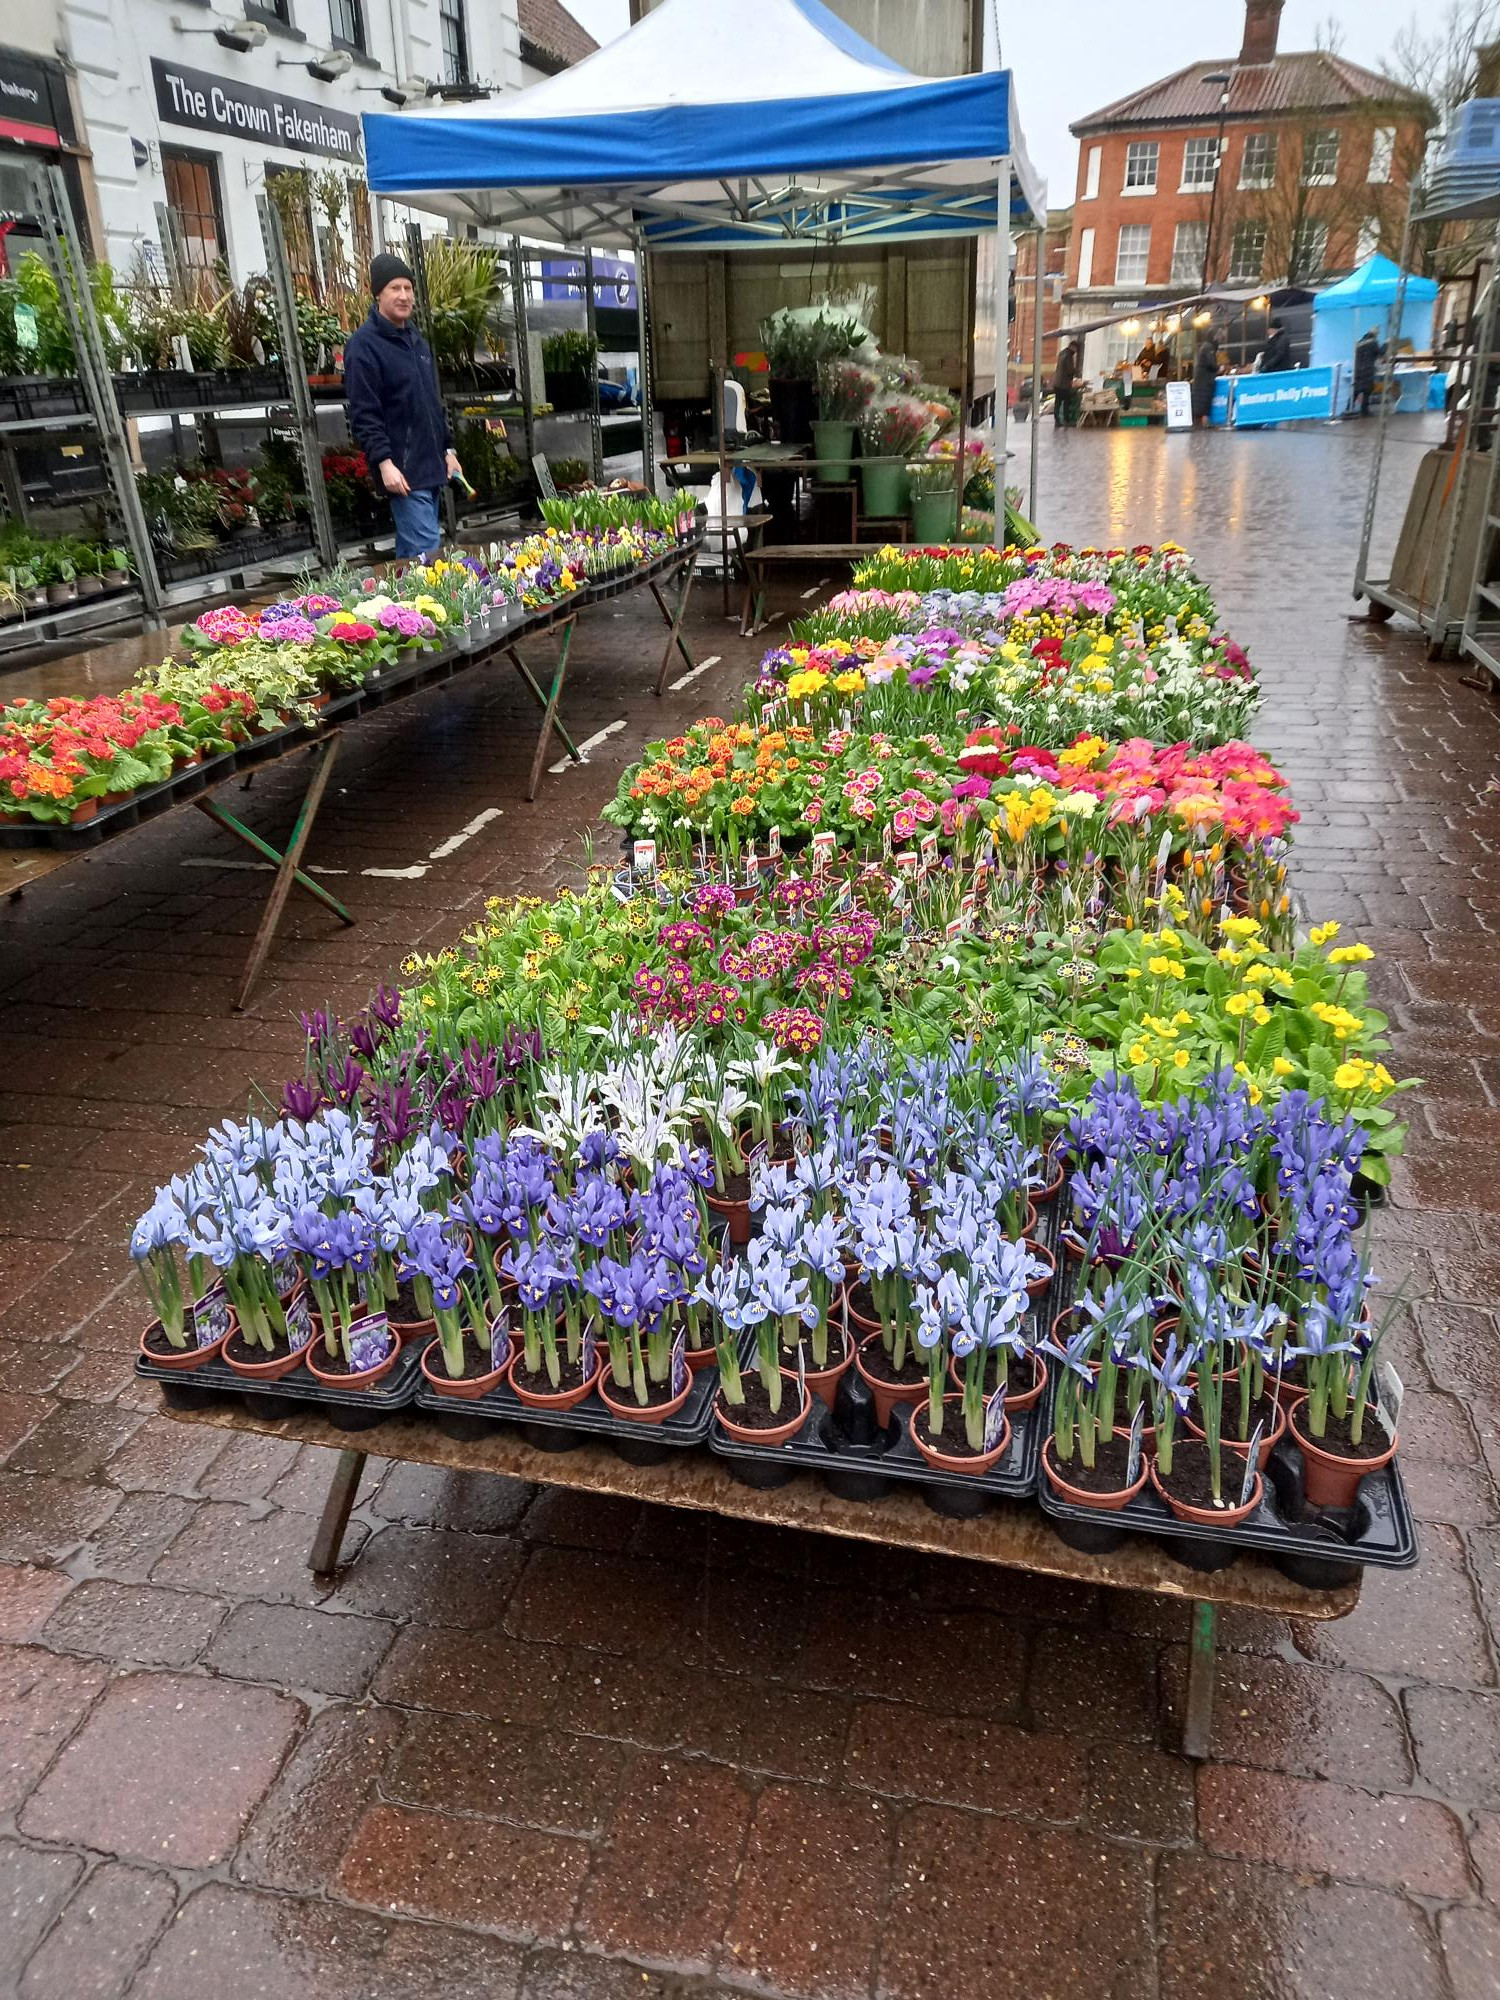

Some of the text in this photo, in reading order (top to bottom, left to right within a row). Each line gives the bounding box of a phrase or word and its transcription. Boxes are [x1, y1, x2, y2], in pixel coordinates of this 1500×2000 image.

[165, 74, 352, 152] The Crown Fakenham
